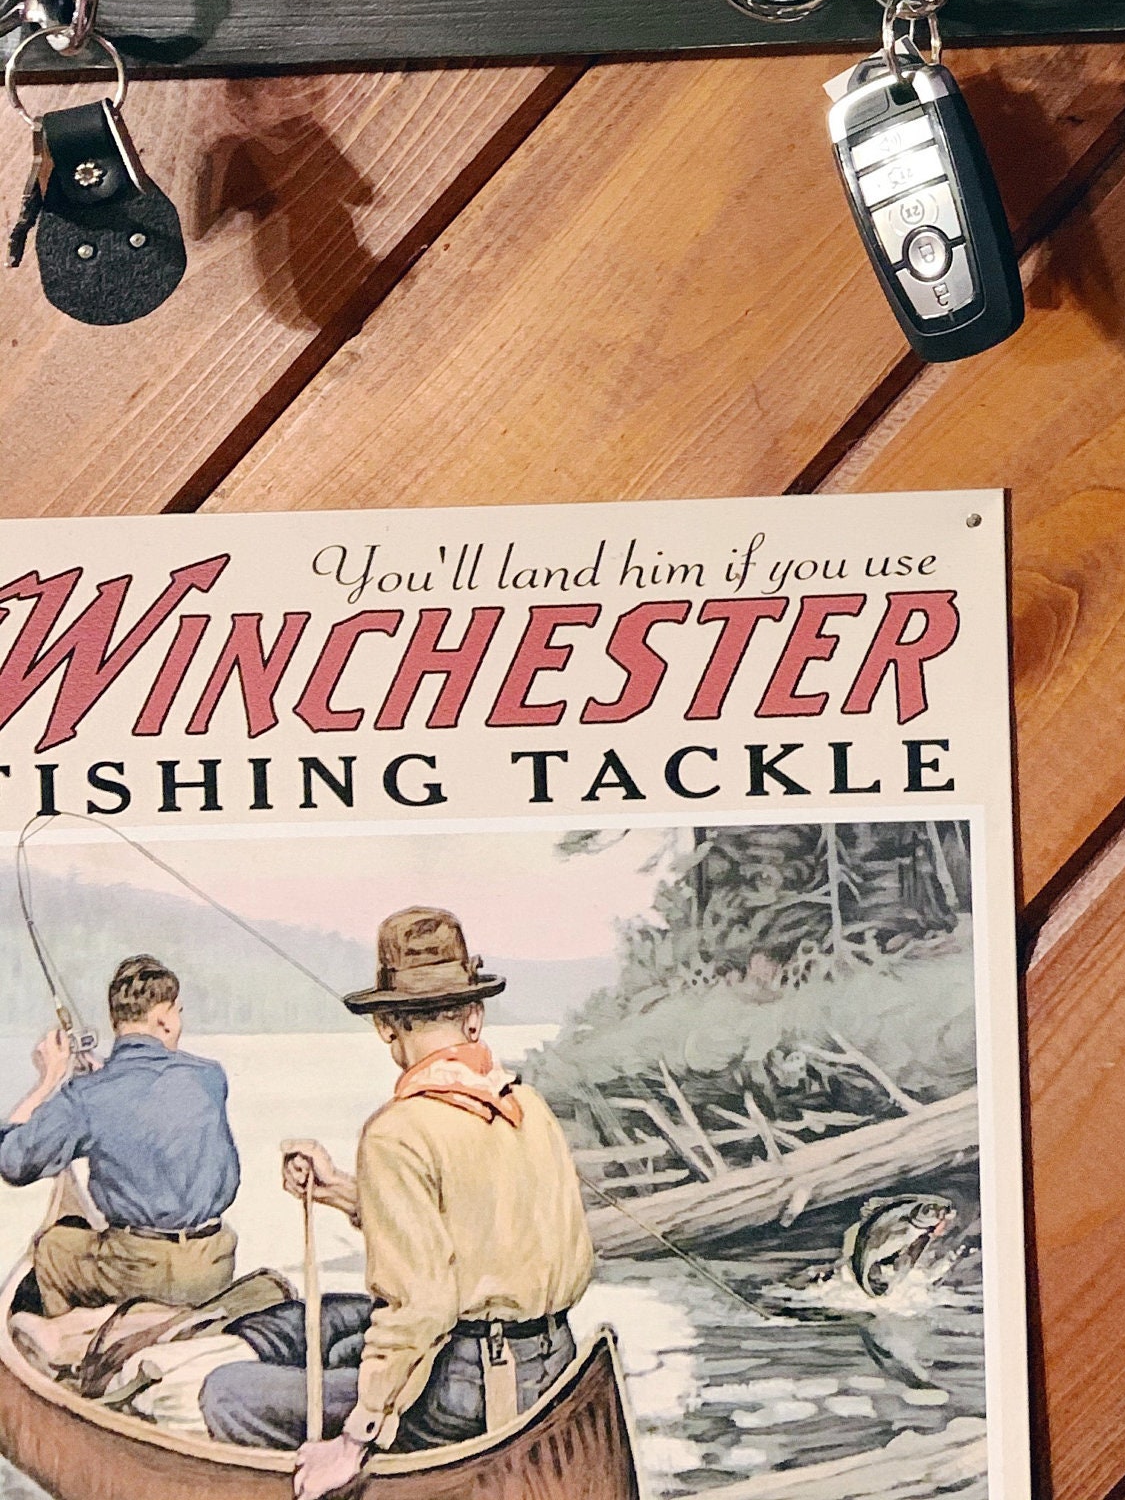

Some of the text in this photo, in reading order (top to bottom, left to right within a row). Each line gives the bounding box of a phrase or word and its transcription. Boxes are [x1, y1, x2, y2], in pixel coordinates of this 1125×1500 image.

[312, 532, 937, 603] You'll land him if you use
[0, 553, 960, 754] WINCHESTER
[0, 738, 956, 816] ISHING TACKLE
